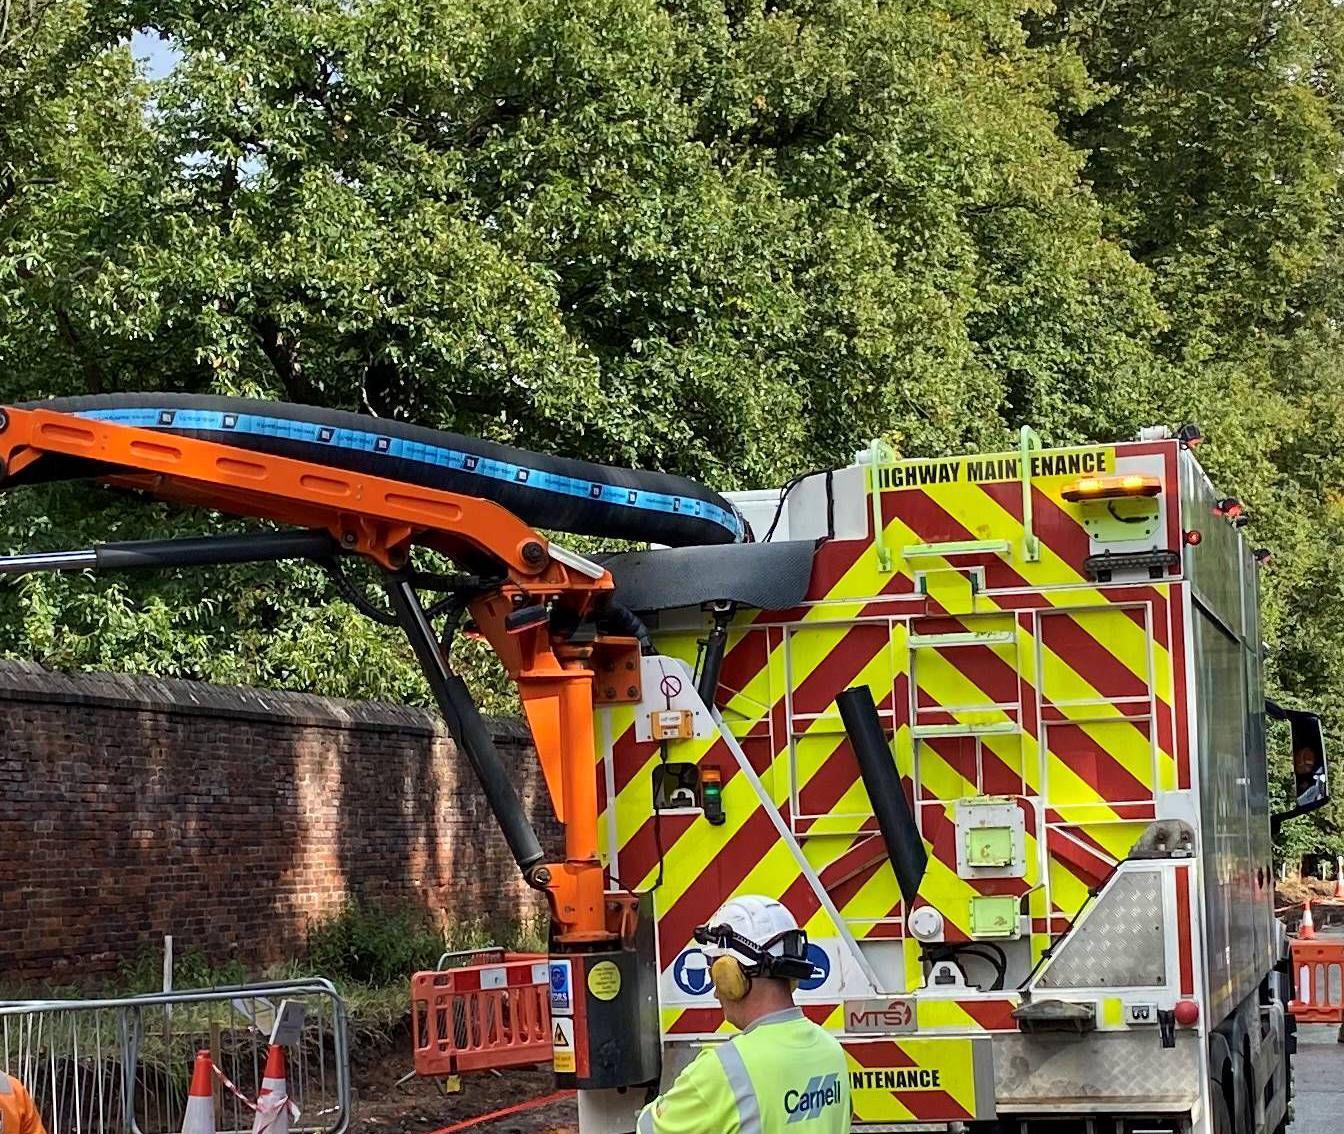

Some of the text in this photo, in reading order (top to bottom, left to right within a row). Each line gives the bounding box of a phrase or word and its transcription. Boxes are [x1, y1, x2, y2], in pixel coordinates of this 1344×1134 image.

[967, 451, 1106, 482] MAINENANCE
[850, 1010, 903, 1027] MTS
[784, 1080, 841, 1114] Carnell
